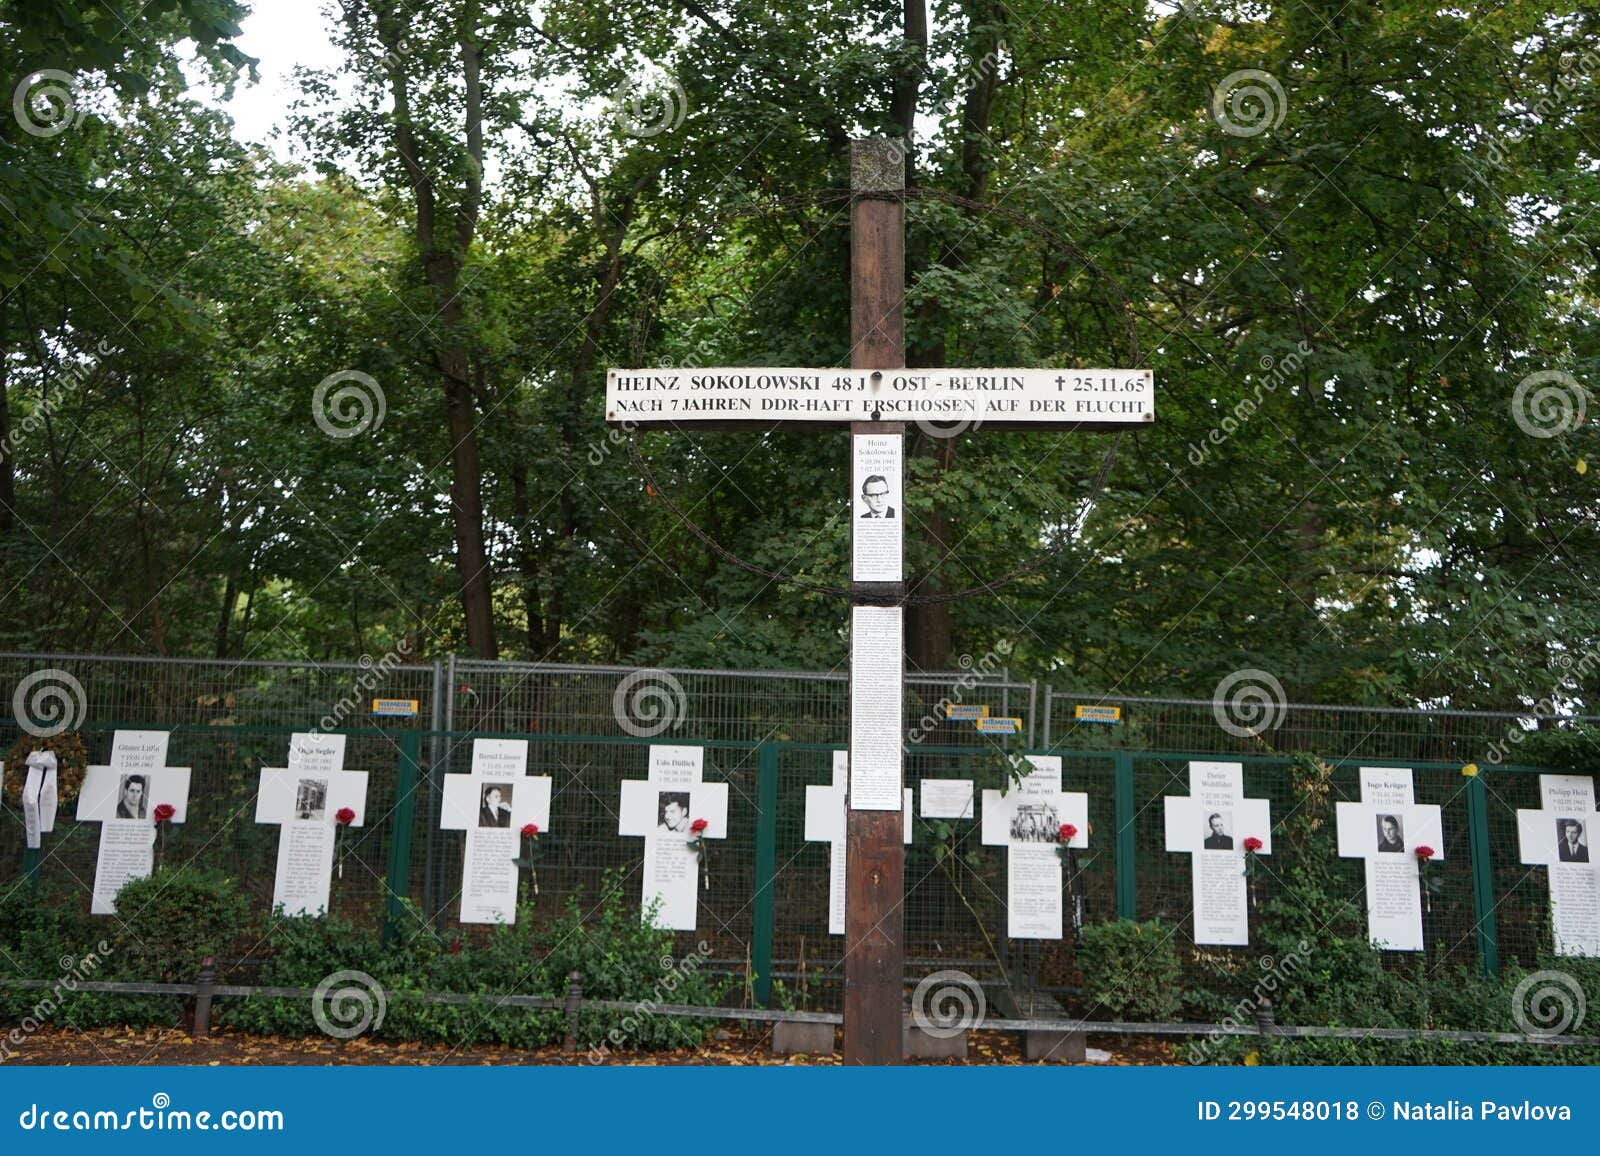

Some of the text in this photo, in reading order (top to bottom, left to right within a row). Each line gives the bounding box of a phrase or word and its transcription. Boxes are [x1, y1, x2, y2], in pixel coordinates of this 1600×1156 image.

[616, 376, 680, 391] HEINZ
[690, 375, 820, 391] SOKOLOWSKI
[831, 376, 852, 391] 48
[892, 376, 929, 391] OST
[949, 376, 1025, 391] BERLIN
[1073, 377, 1145, 393] 25.11.65
[615, 398, 1145, 414] NACH 7 JAHREN DDR-HAFT ERSCHOSSEN AUF DER FLUCHT
[867, 439, 888, 447] Heinz
